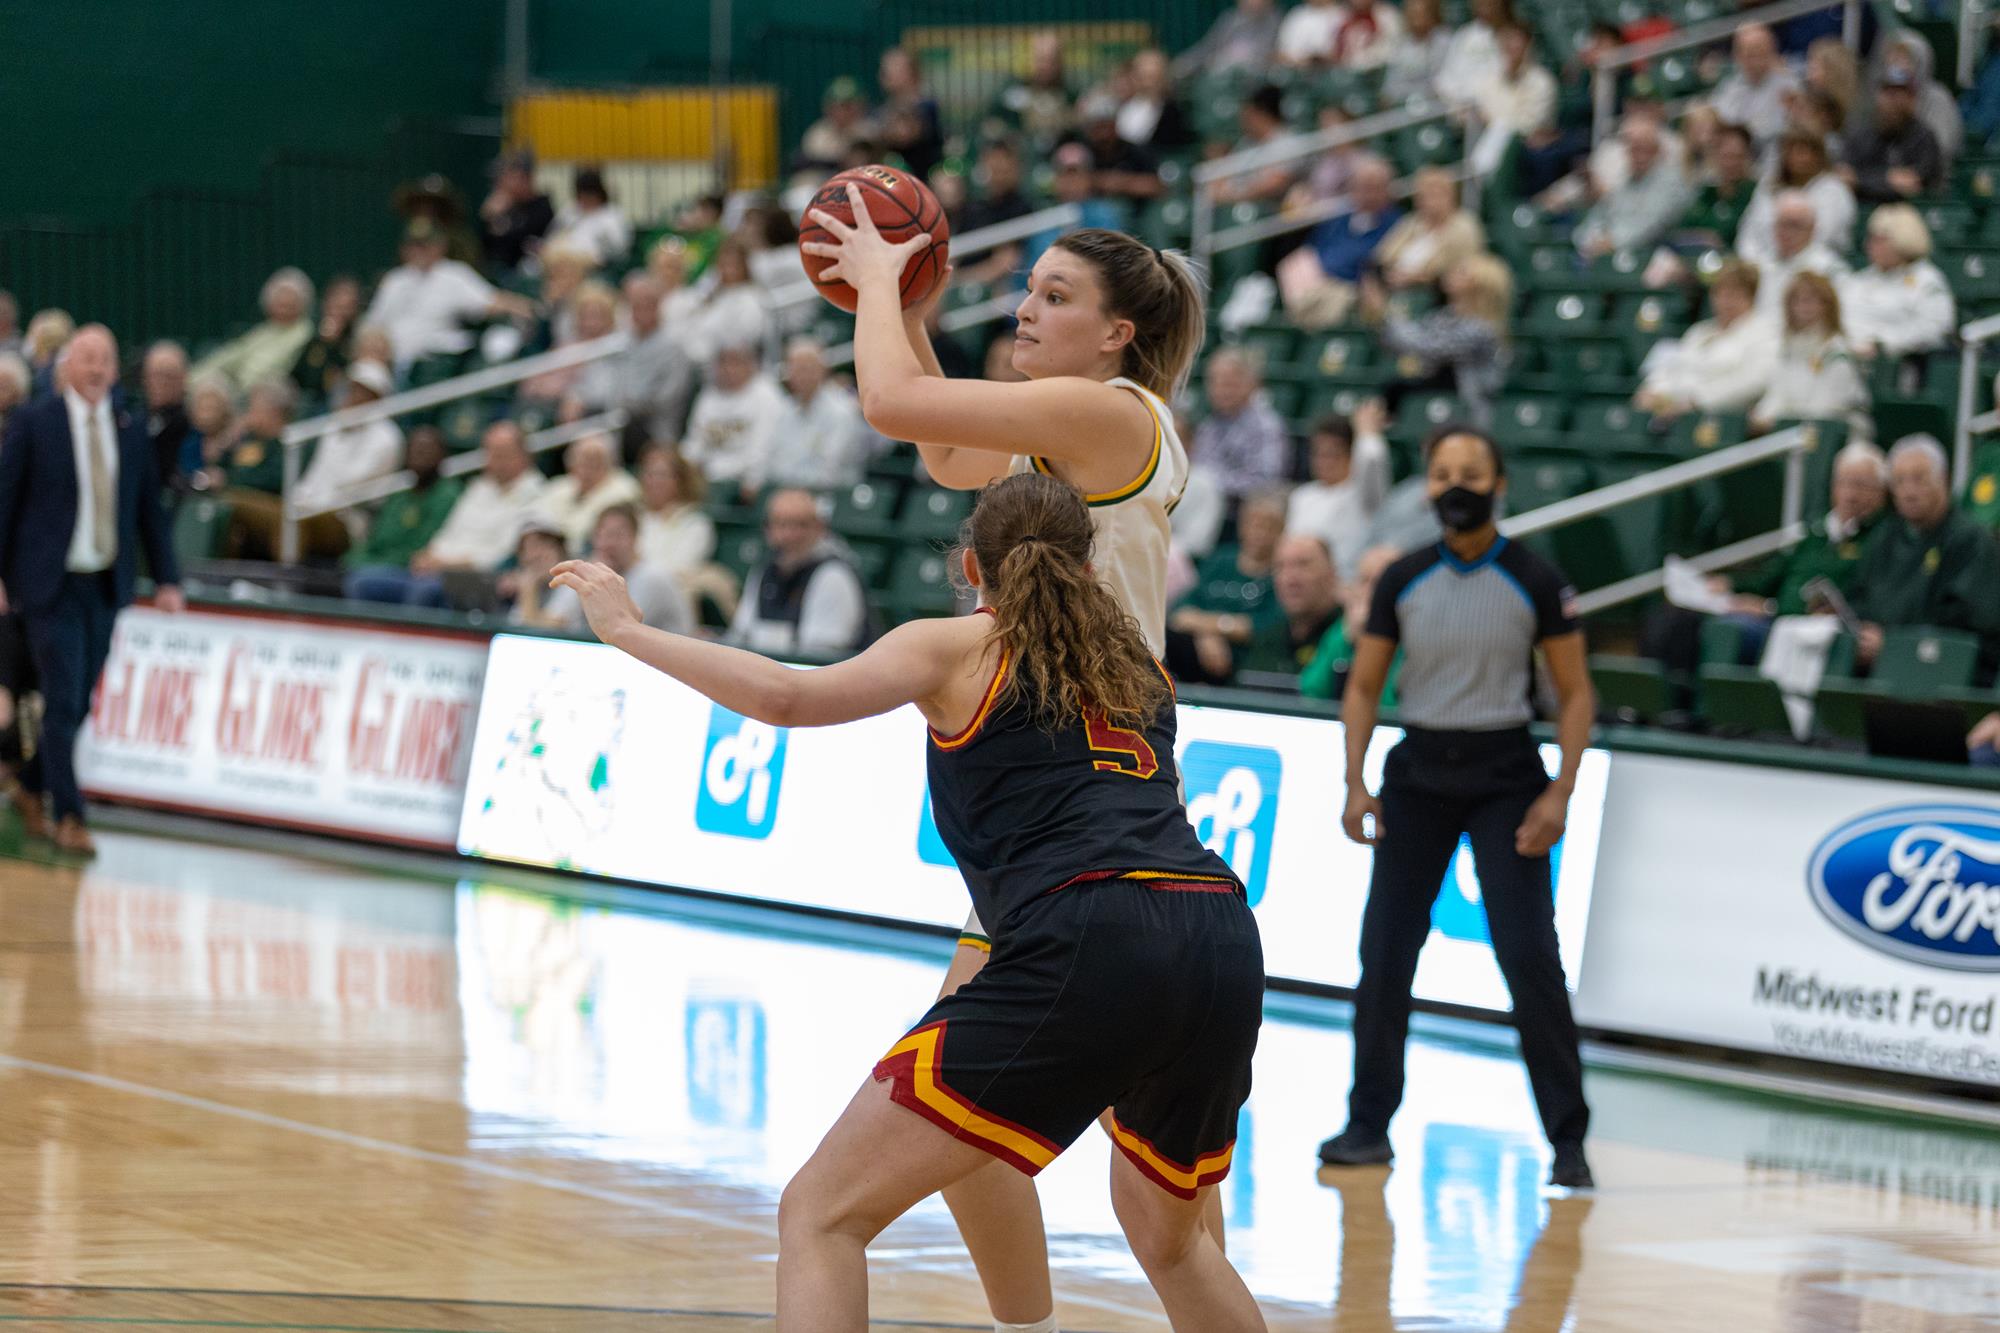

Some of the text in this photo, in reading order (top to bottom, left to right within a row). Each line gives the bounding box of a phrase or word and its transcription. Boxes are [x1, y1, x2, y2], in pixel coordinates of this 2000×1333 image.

[1077, 690, 1158, 780] 5
[1862, 824, 2000, 946] For
[1754, 968, 1993, 1034] Midwest Ford
